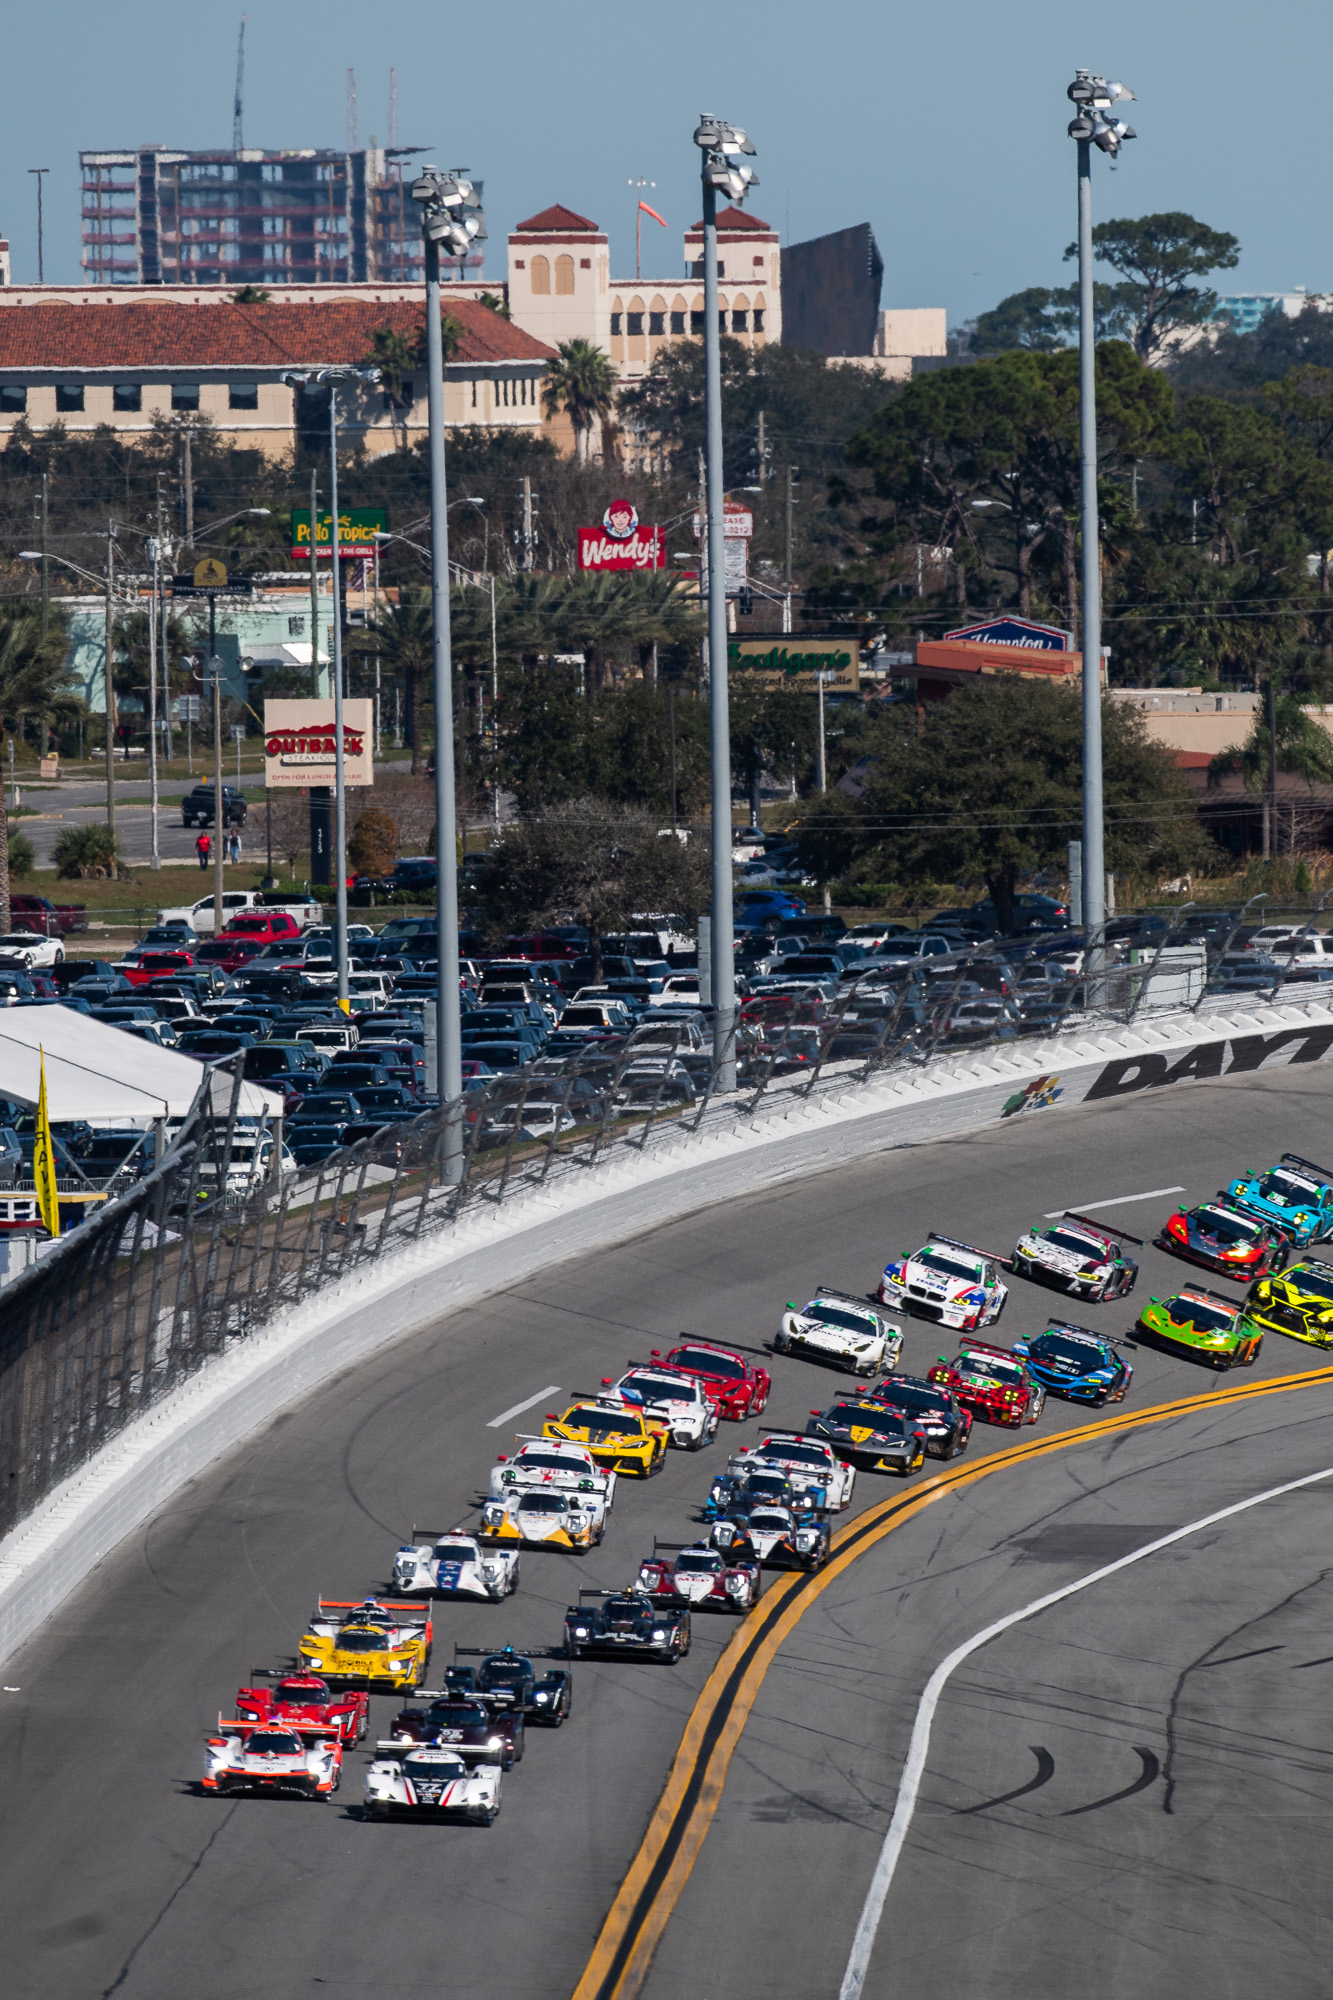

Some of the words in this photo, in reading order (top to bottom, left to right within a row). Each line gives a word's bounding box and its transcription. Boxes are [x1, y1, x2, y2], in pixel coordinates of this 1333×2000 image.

[337, 524, 381, 541] ropical
[583, 533, 660, 567] Wendy's
[1062, 1334, 1099, 1349] ACURA
